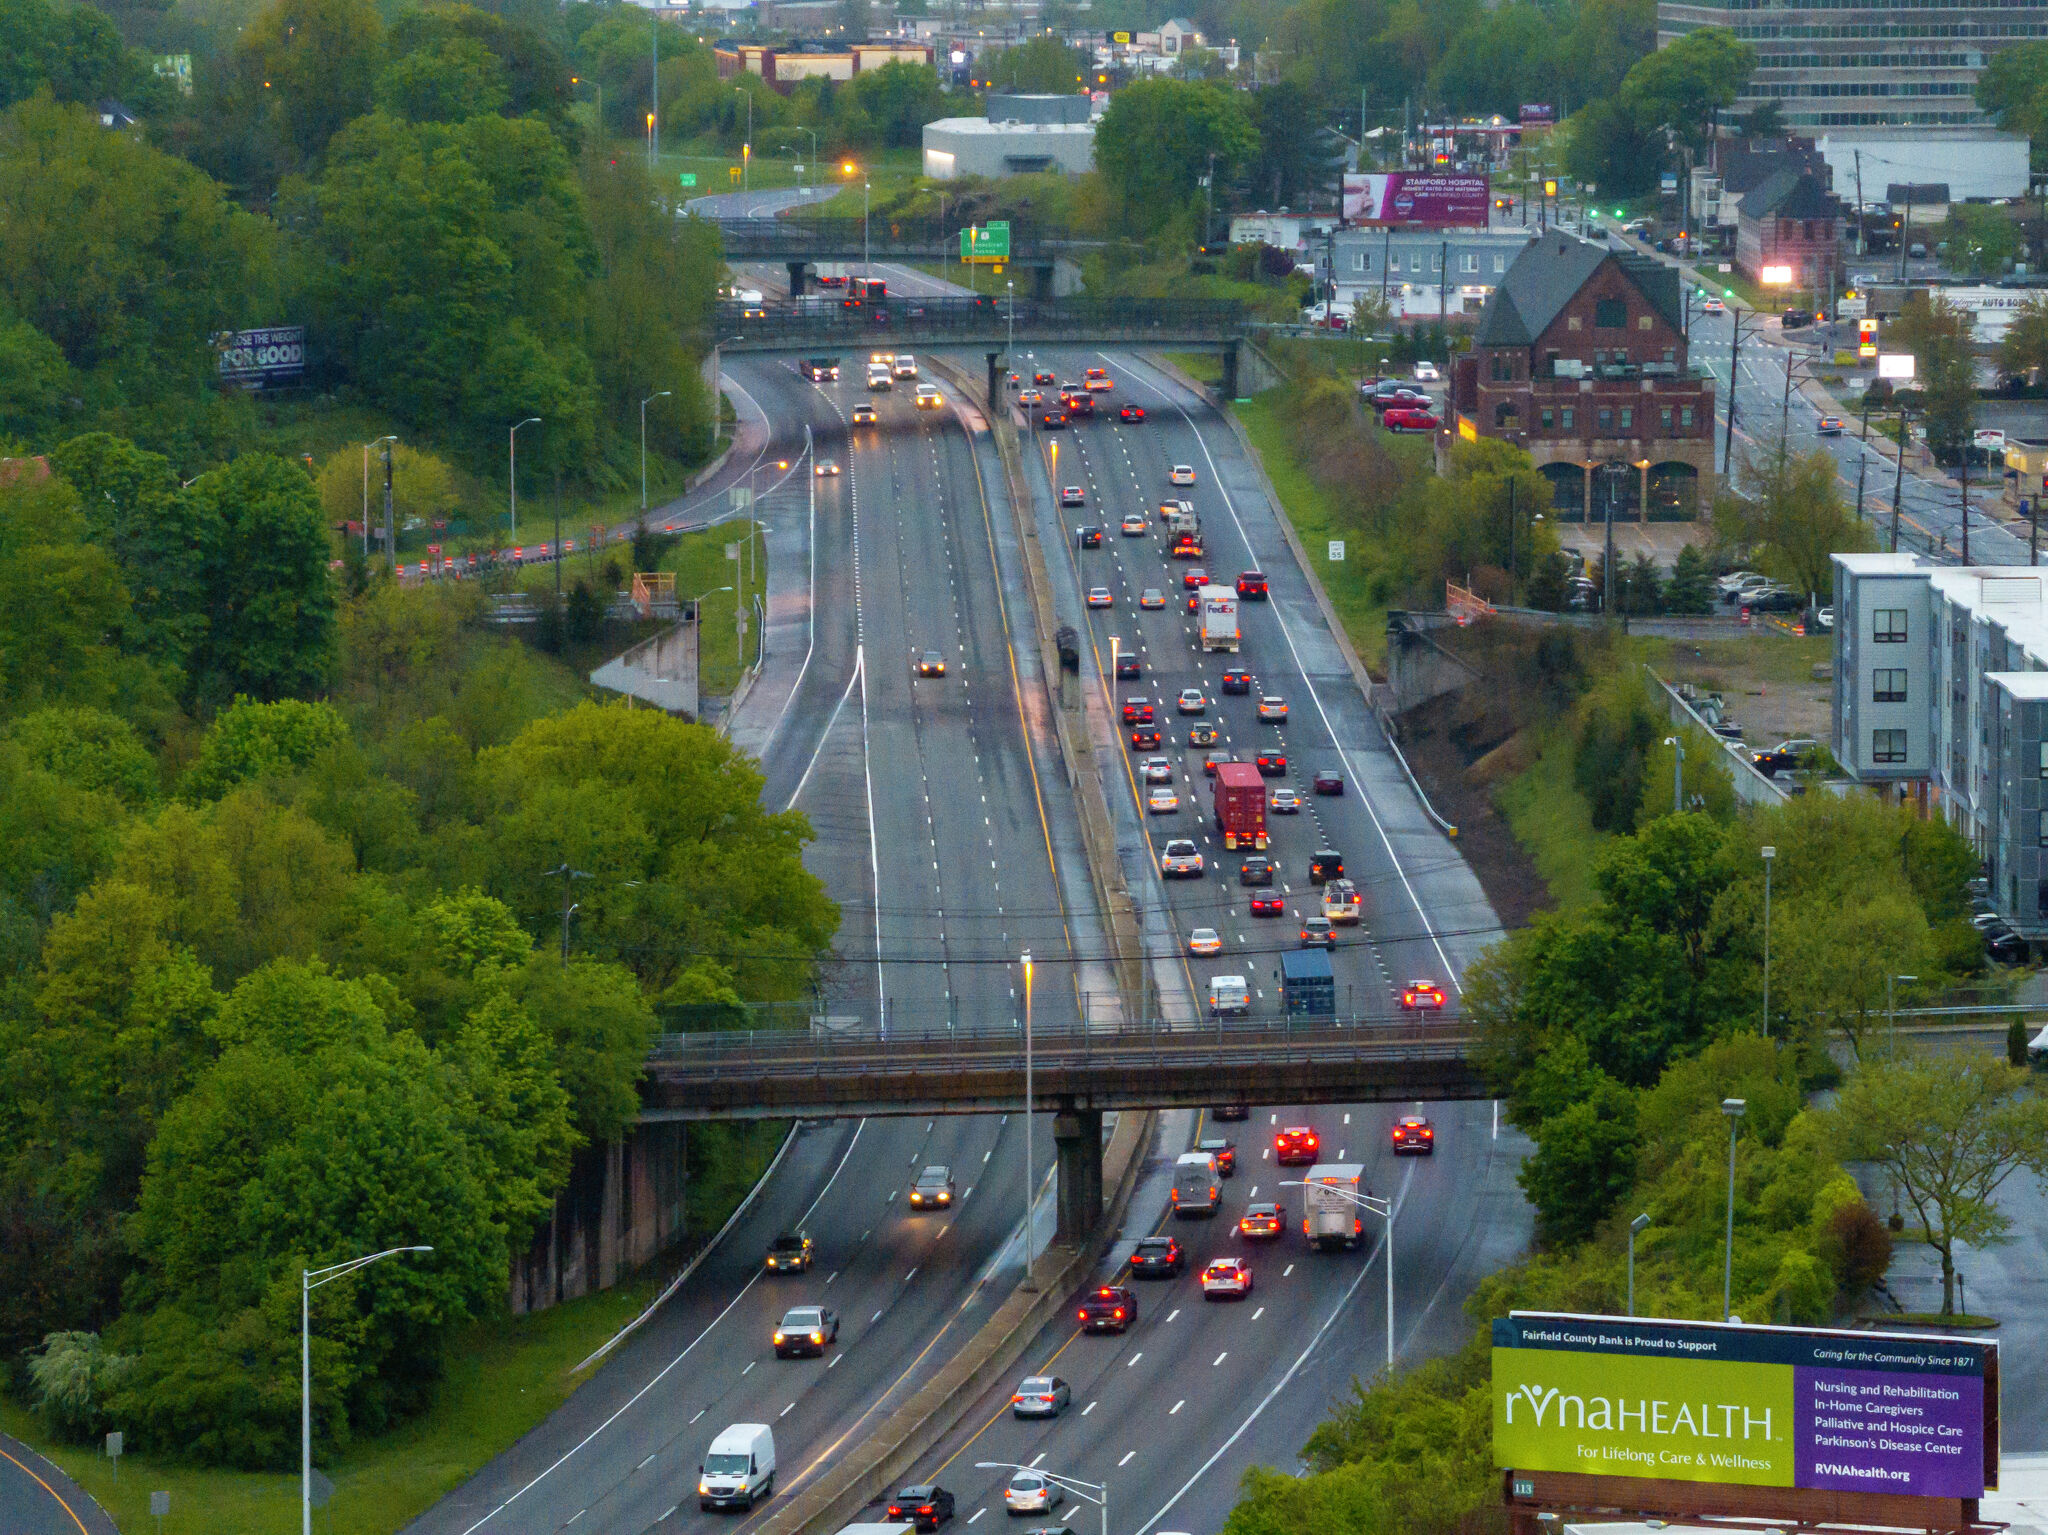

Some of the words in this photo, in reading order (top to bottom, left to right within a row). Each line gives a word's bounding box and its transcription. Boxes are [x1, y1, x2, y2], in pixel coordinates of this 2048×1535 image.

[1405, 178, 1447, 186] STAMFORD
[1448, 178, 1485, 186] HOSPITAL
[1982, 298, 2004, 307] AUTO
[254, 333, 269, 344] THE
[270, 330, 303, 342] WEIGHT
[255, 344, 301, 365] GOOD
[1331, 551, 1342, 559] 55
[1207, 604, 1235, 614] FedEx
[1522, 1330, 1561, 1342] Fairfield
[1563, 1333, 1597, 1346] County
[1599, 1335, 1623, 1346] Bank
[1625, 1336, 1633, 1346] is
[1634, 1337, 1663, 1348] Proud
[1665, 1338, 1676, 1349] to
[1677, 1339, 1717, 1352] Support
[1813, 1348, 1843, 1362] Caring
[1844, 1350, 1857, 1361] for
[1858, 1351, 1873, 1362] the
[1874, 1352, 1926, 1366] Community
[1928, 1355, 1951, 1366] Since
[1953, 1356, 1974, 1367] 1871
[1815, 1380, 1857, 1396] Nursing
[1860, 1384, 1881, 1396] and
[1883, 1385, 1960, 1401] Rehabilitation
[1815, 1399, 1863, 1413] In-Home
[1865, 1402, 1924, 1417] Caregivers
[1815, 1416, 1864, 1431] Palliative
[1867, 1420, 1888, 1432] and
[1890, 1421, 1935, 1436] Hospice
[1937, 1424, 1964, 1437] Care
[1815, 1434, 1877, 1449] Parkinson's
[1879, 1438, 1922, 1452] Disease
[1924, 1442, 1962, 1455] Center
[1577, 1444, 1599, 1458] For
[1602, 1447, 1655, 1466] Lifelong
[1659, 1450, 1692, 1465] Care
[1696, 1454, 1707, 1466] &
[1710, 1454, 1772, 1470] Wellness
[1815, 1463, 1910, 1482] RVNAhealth.org
[1515, 1483, 1532, 1495] 113
